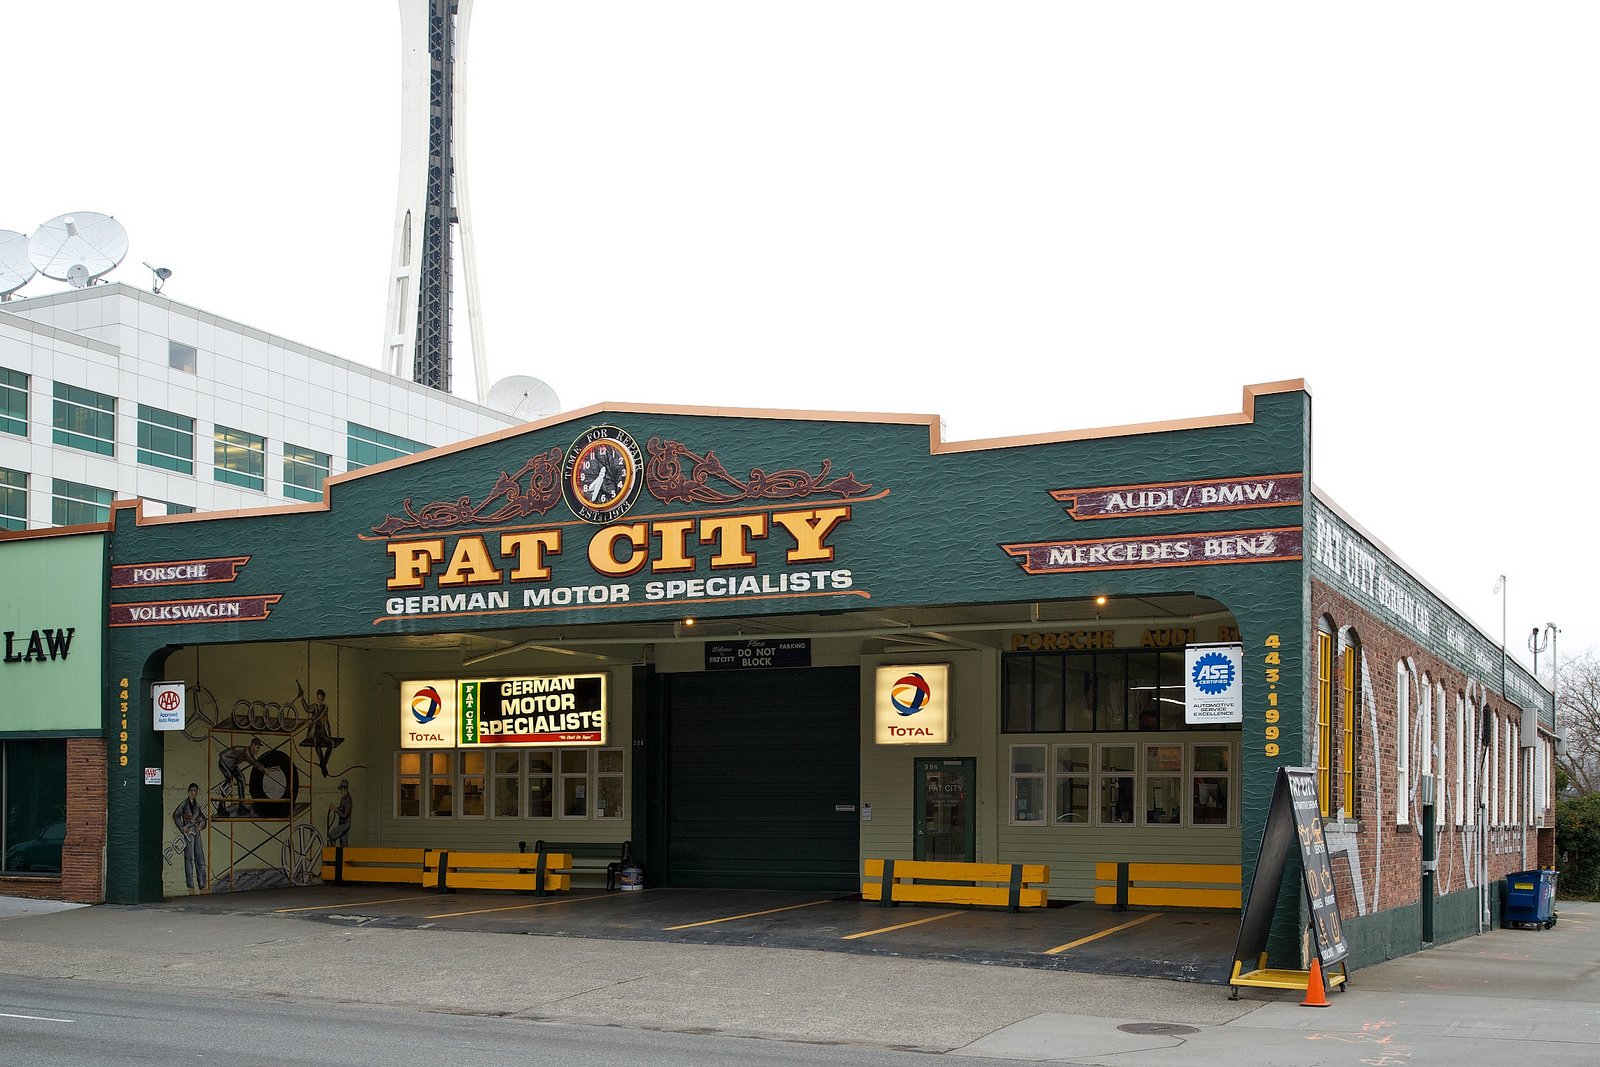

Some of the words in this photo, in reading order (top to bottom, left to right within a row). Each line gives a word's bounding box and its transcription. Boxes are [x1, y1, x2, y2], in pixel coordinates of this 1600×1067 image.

[564, 445, 582, 480] TIME
[586, 428, 608, 443] FOR
[615, 431, 642, 472] REPAIR
[590, 452, 596, 460] 11
[600, 447, 607, 456] 12
[619, 457, 624, 465] 2
[583, 461, 591, 470] 10
[622, 469, 627, 477] 3
[580, 473, 586, 481] 9
[617, 481, 623, 489] 4
[601, 494, 606, 503] 6
[611, 490, 616, 498] 5
[1105, 490, 1174, 512] AUDI
[1200, 482, 1276, 503] BMW
[608, 501, 631, 520] 1973
[386, 529, 563, 591] FAT
[587, 505, 852, 578] CITY
[1049, 542, 1190, 566] MERCEDES
[1203, 533, 1278, 556] BENZ
[133, 564, 209, 582] PORSCHE
[386, 590, 510, 615] GERMAN
[523, 583, 630, 608] MOTOR
[645, 569, 853, 600] SPECIALISTS
[129, 602, 240, 621] VOLKSWAGEN
[3, 628, 75, 663] LAW
[1011, 630, 1115, 652] PORSCHE
[1141, 627, 1196, 648] AUDI
[737, 648, 752, 657] DO
[756, 647, 776, 657] NOT
[742, 658, 772, 667] BLOCK
[1197, 664, 1229, 680] ASE
[501, 677, 575, 697] GERMAN
[158, 691, 180, 710] AAA
[465, 685, 474, 709] FAT
[501, 693, 575, 716] MOTOR
[465, 710, 474, 741] CITY
[480, 710, 602, 735] SPECIALISTS
